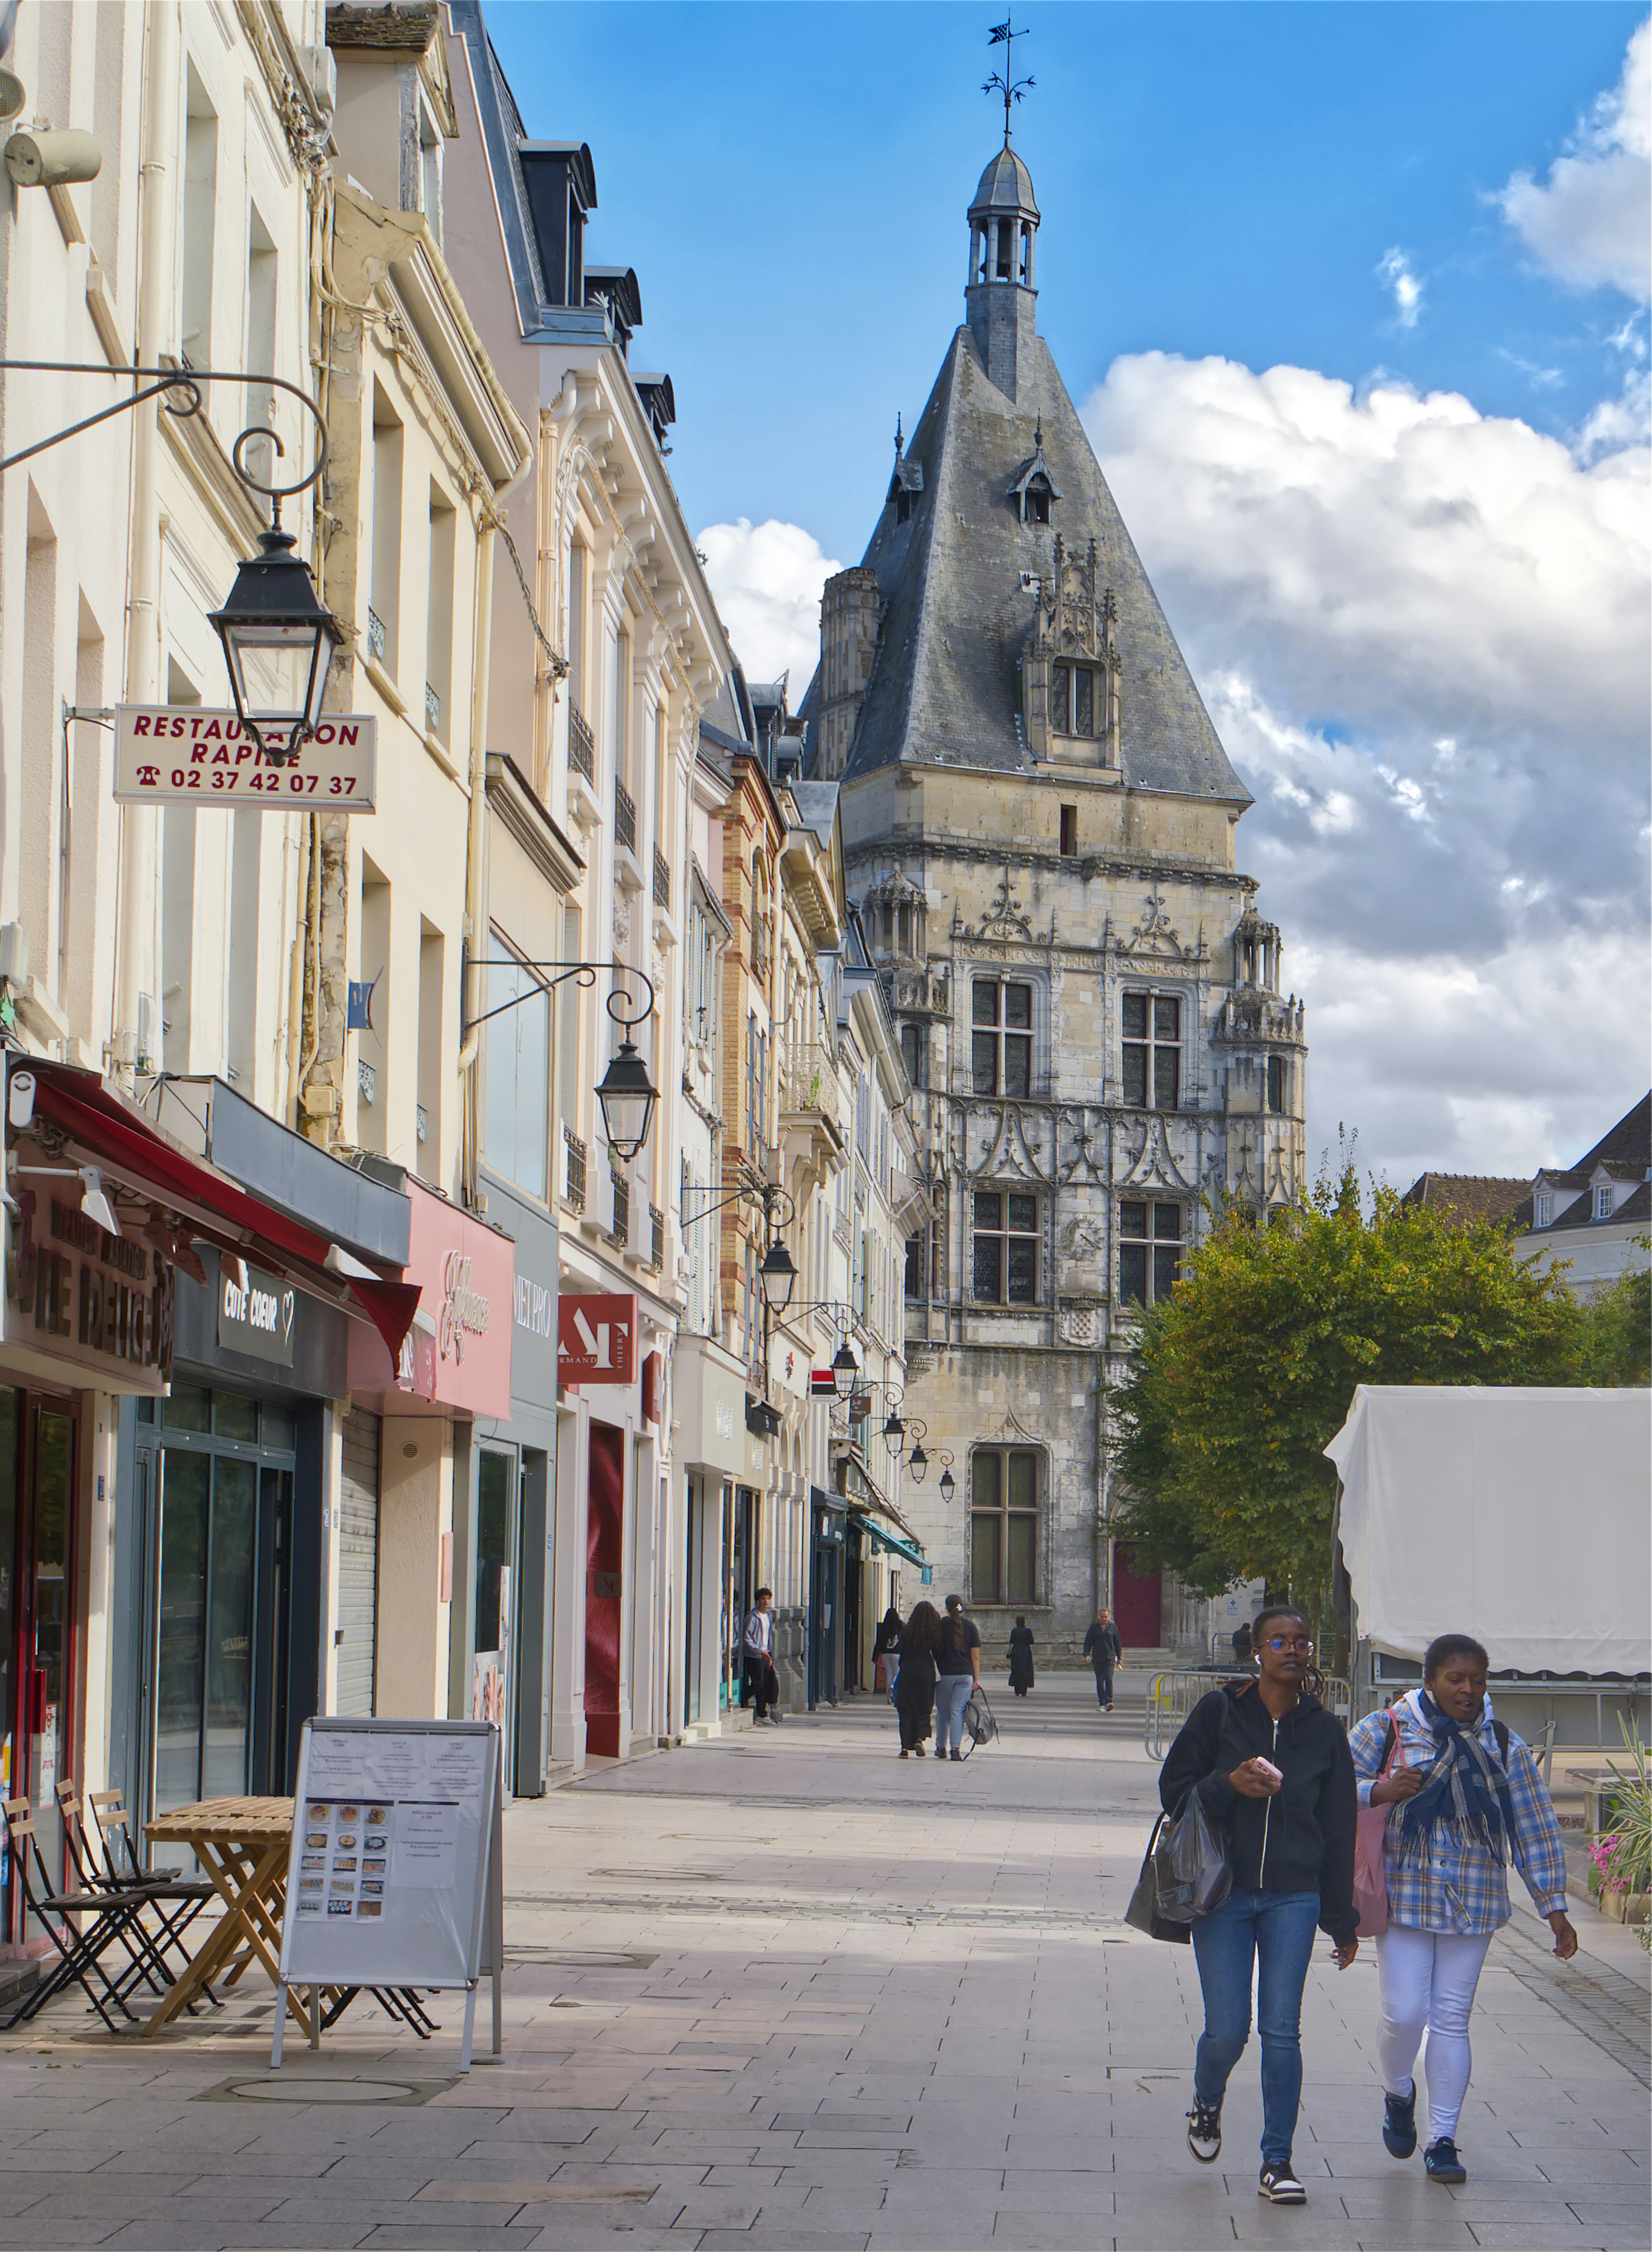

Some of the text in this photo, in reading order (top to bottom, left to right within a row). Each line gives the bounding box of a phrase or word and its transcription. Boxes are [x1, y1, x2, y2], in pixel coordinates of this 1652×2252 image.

[133, 715, 359, 746] RESTAUON
[190, 743, 301, 768] RAPIE
[171, 769, 357, 795] 02 37 42 07 37
[532, 1283, 551, 1338] PRO
